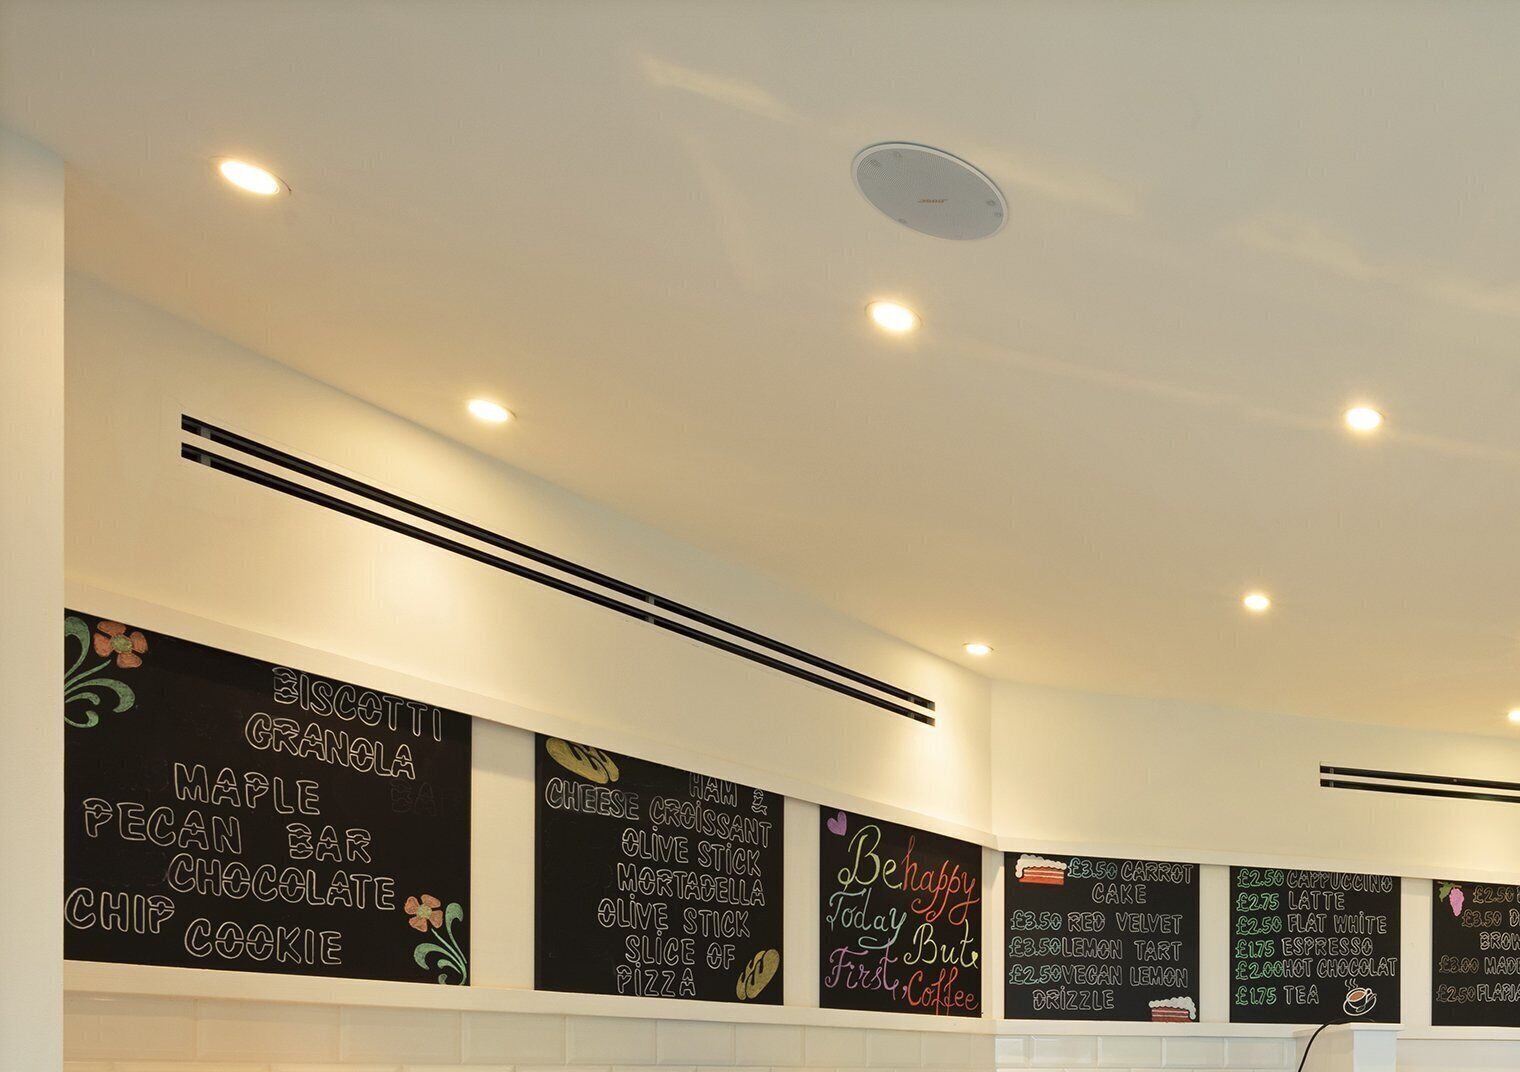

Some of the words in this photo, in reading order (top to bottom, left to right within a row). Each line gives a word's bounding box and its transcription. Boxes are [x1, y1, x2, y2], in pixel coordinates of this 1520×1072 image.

[273, 667, 442, 741] BISCOTTI
[245, 713, 415, 780] GRANOLA
[174, 763, 320, 815] MAPLE
[689, 772, 738, 807] HAM
[545, 777, 640, 820] CHEESE
[650, 796, 772, 848] CROISSANT
[83, 798, 241, 854] PECAN
[286, 823, 371, 863] BAR
[622, 825, 688, 863] OLIVE
[698, 840, 761, 877] STICK
[168, 853, 395, 910] CHOCOLATE
[617, 862, 765, 906] MORTADELLA
[837, 824, 902, 892] Be
[901, 835, 980, 925] happy
[1067, 858, 1118, 879] £3.50
[1121, 861, 1194, 884] CARROT
[1237, 868, 1284, 888] £2.50
[1287, 870, 1392, 893] CAPPUCCINO
[65, 888, 174, 934] CHIP
[1092, 883, 1147, 904] CAKE
[1236, 892, 1279, 912] £2.75
[1288, 890, 1345, 910] LATTE
[1472, 885, 1514, 904] £2.50
[597, 893, 669, 930] OLIVE
[683, 907, 751, 938] STICK
[826, 887, 907, 949] Today
[903, 919, 978, 968] But
[1011, 910, 1062, 930] £3.50
[1067, 911, 1105, 931] RED
[1116, 912, 1183, 934] VELVET
[1236, 916, 1282, 935] £2.50
[1287, 912, 1327, 933] FLAT
[1333, 911, 1387, 934] WHITE
[1462, 909, 1502, 928] £3.50
[184, 918, 342, 965] COOKIE
[625, 930, 695, 965] SLICE
[706, 942, 735, 970] OF
[1009, 936, 1061, 957] £3.50
[1061, 937, 1122, 959] LEMON
[1134, 940, 1182, 961] TART
[1235, 939, 1275, 958] £1.75
[1281, 937, 1373, 956] ESPRESSO
[617, 961, 696, 997] PIZZA
[1009, 964, 1062, 985] £2.50
[1062, 965, 1122, 985] VEGAN
[1130, 966, 1188, 987] LEMON
[1235, 961, 1283, 980] £2.00
[1283, 958, 1313, 978] HOT
[1317, 957, 1397, 978] CHOCOLAT
[1438, 955, 1479, 974] £3.00
[907, 967, 978, 1016] Coffee
[1033, 985, 1114, 1010] DRIZZLE
[1235, 986, 1276, 1005] £1.75
[1283, 984, 1319, 1005] TEA
[1436, 984, 1475, 1003] £2.50
